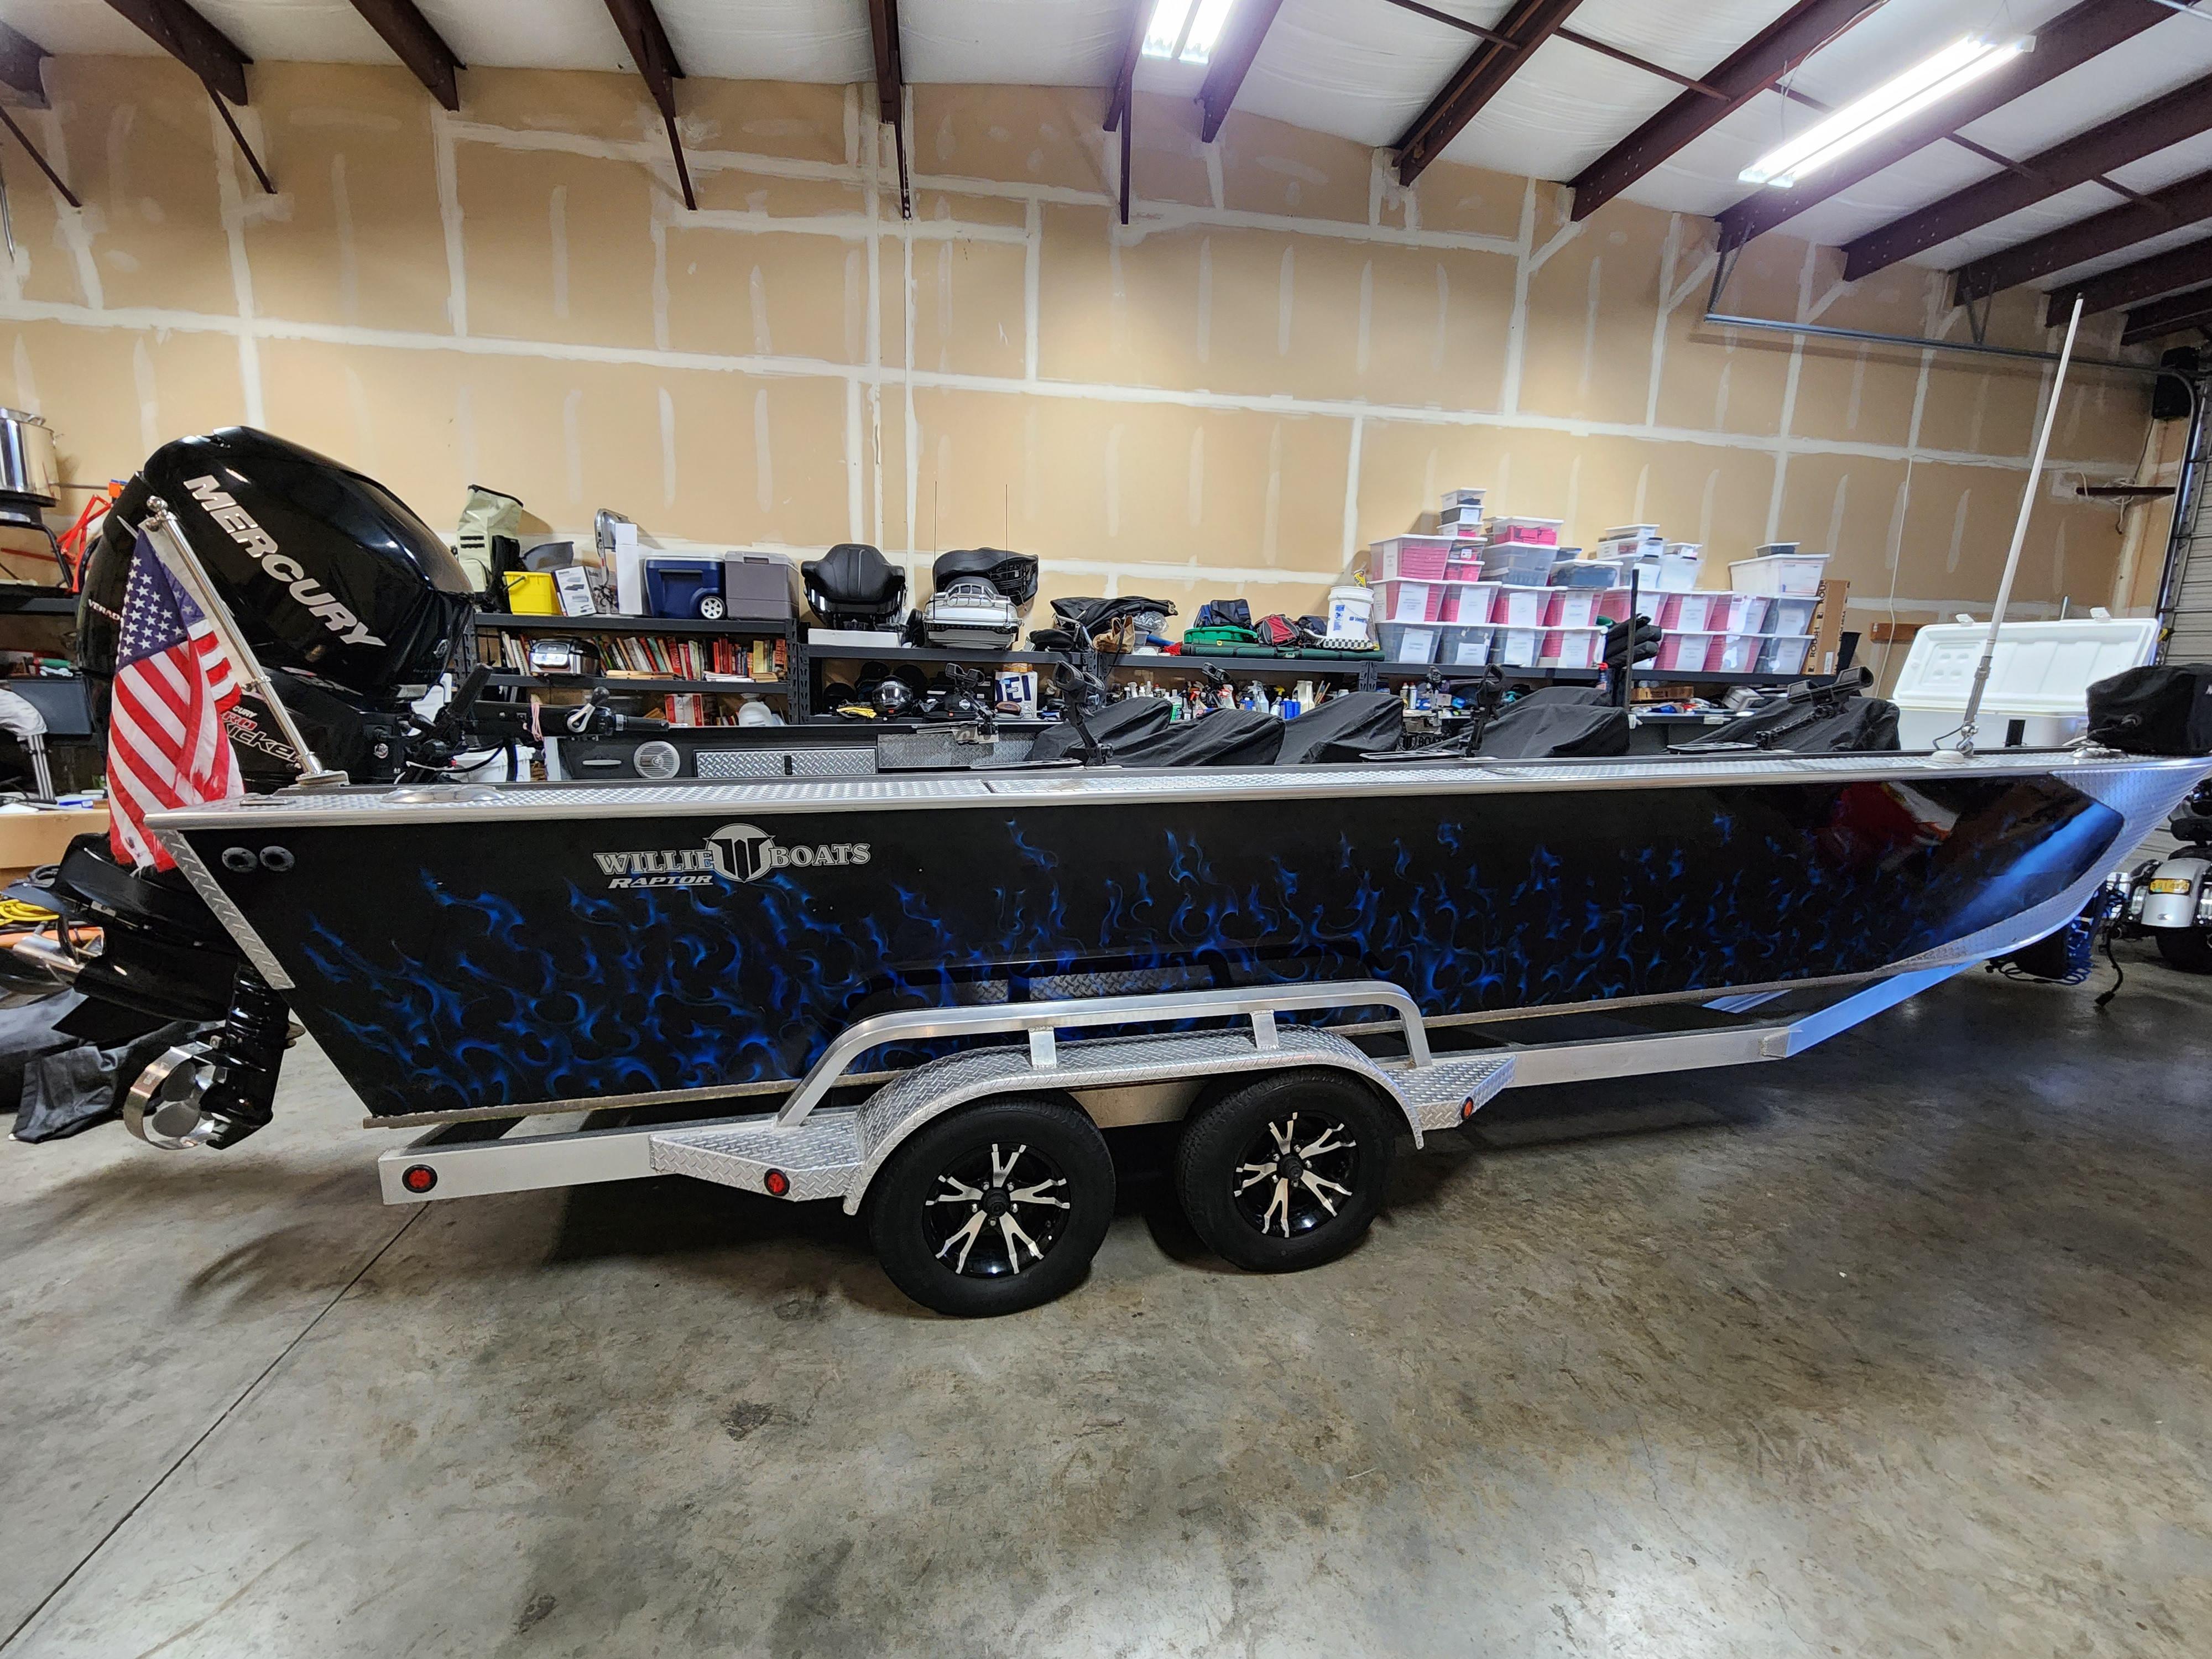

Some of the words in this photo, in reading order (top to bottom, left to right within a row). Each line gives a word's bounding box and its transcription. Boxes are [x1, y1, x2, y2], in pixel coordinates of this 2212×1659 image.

[183, 474, 387, 646] MERCURY
[593, 849, 714, 875] WILLIE
[768, 843, 872, 868] BOATS
[608, 875, 713, 889] RAPTOR
